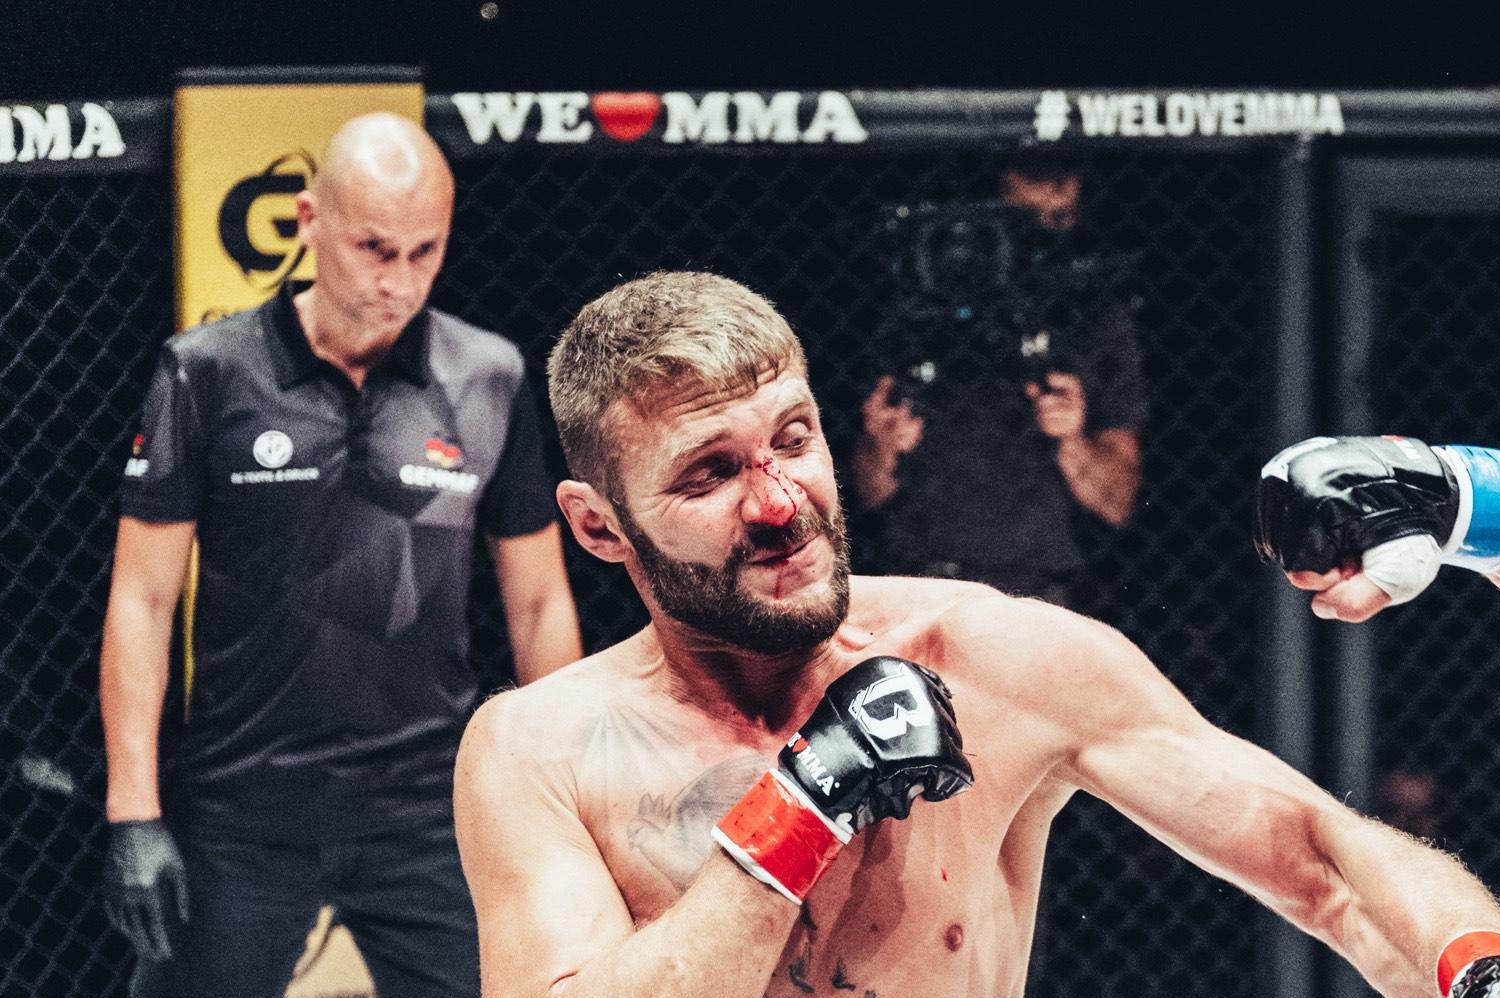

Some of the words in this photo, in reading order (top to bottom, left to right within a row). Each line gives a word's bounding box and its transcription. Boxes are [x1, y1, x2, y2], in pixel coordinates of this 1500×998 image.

[451, 91, 593, 145] WE
[661, 90, 869, 144] MMA
[797, 746, 835, 797] MMA
